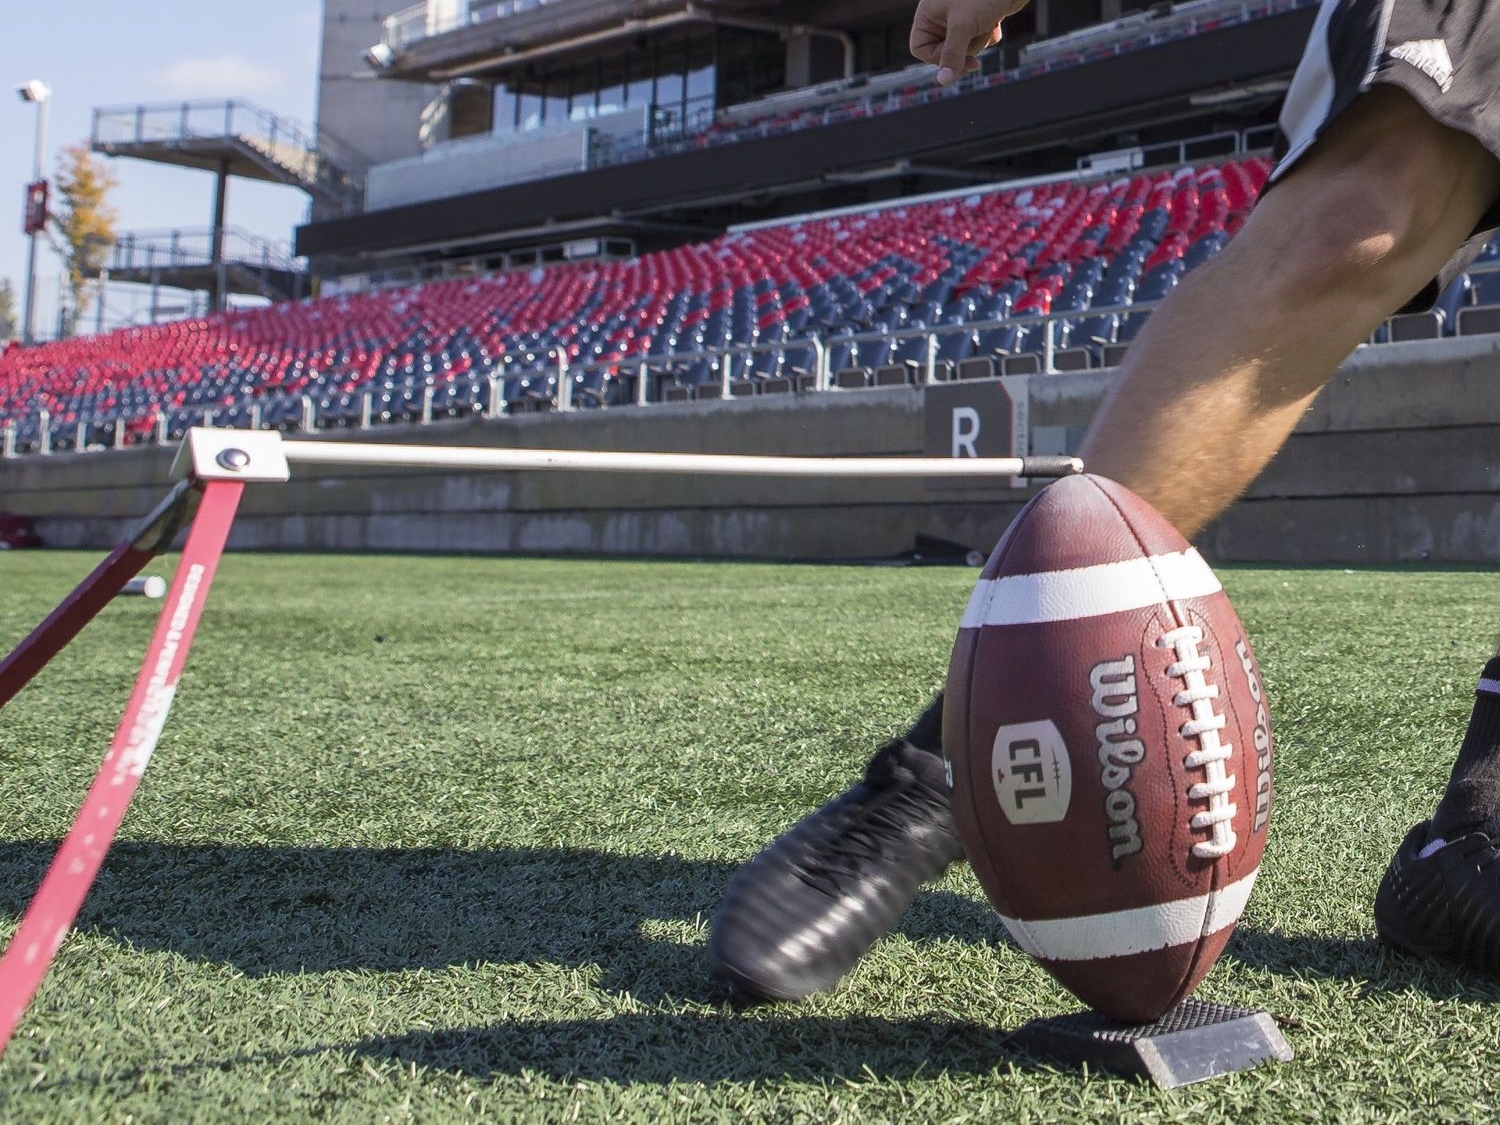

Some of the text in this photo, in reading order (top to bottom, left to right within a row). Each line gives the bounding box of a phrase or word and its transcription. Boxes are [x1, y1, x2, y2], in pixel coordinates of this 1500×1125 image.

[951, 406, 980, 458] R
[1008, 738, 1047, 810] CFL
[1089, 654, 1146, 861] Wilson
